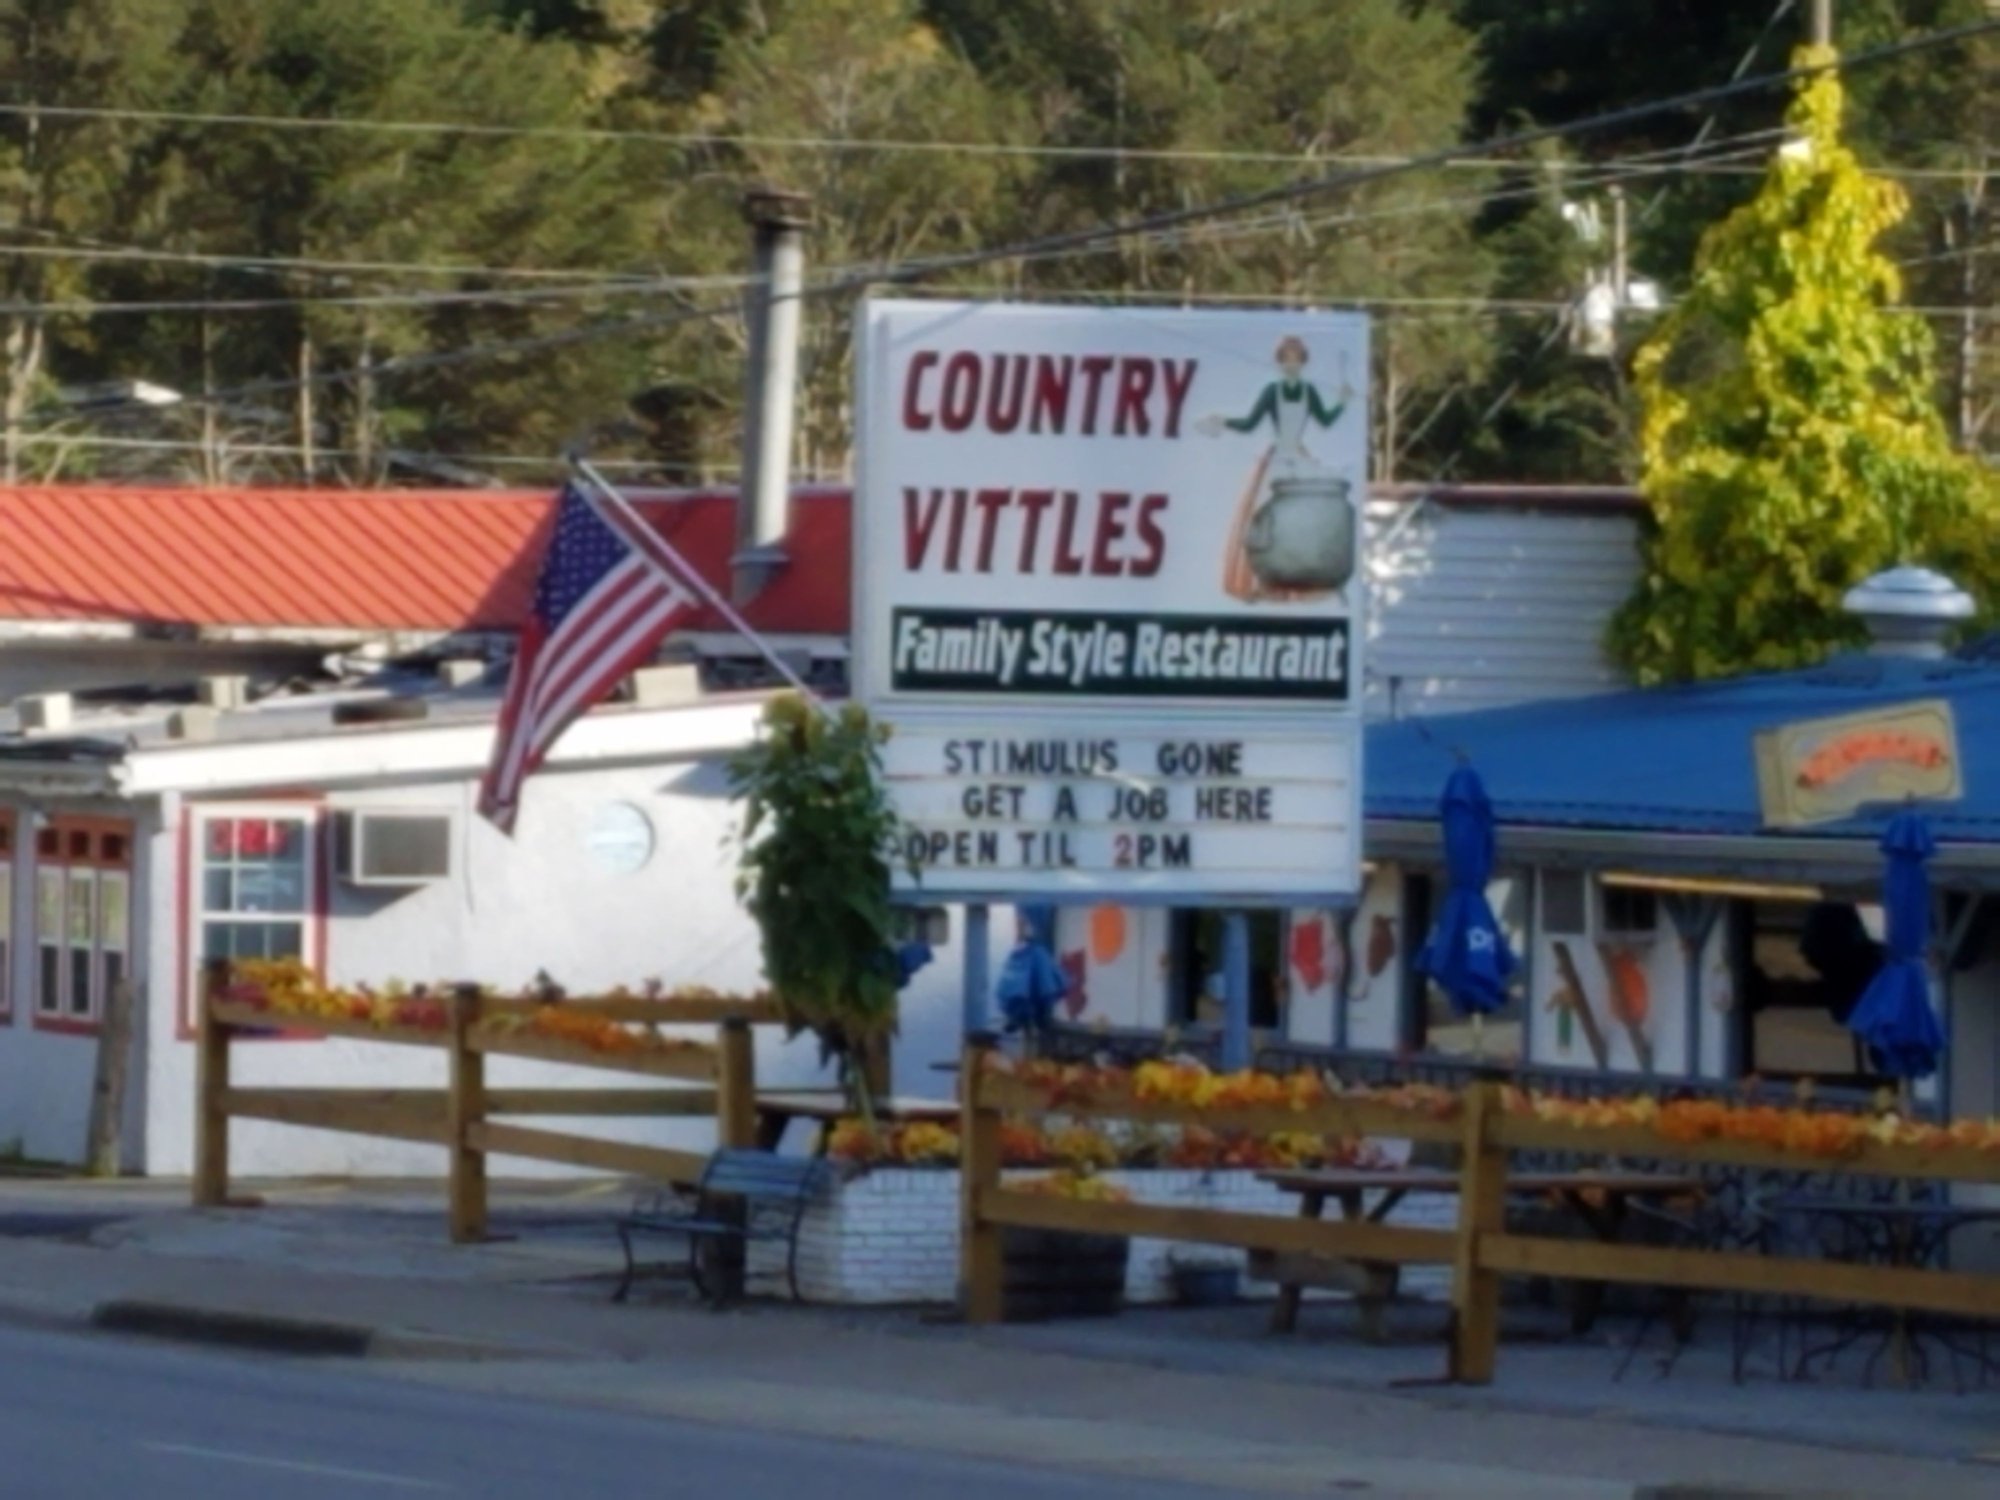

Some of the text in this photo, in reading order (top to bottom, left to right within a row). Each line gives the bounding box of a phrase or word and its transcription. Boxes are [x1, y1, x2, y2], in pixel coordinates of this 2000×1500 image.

[902, 350, 1198, 438] COUNTRY
[902, 487, 1170, 577] VITTLES
[897, 616, 1346, 685] Family Style Restaurant
[944, 739, 1244, 776] STIMULUS GONE
[962, 786, 1272, 822] GET A JOB HERE
[906, 831, 1193, 868] OPEN TIL 2PM
